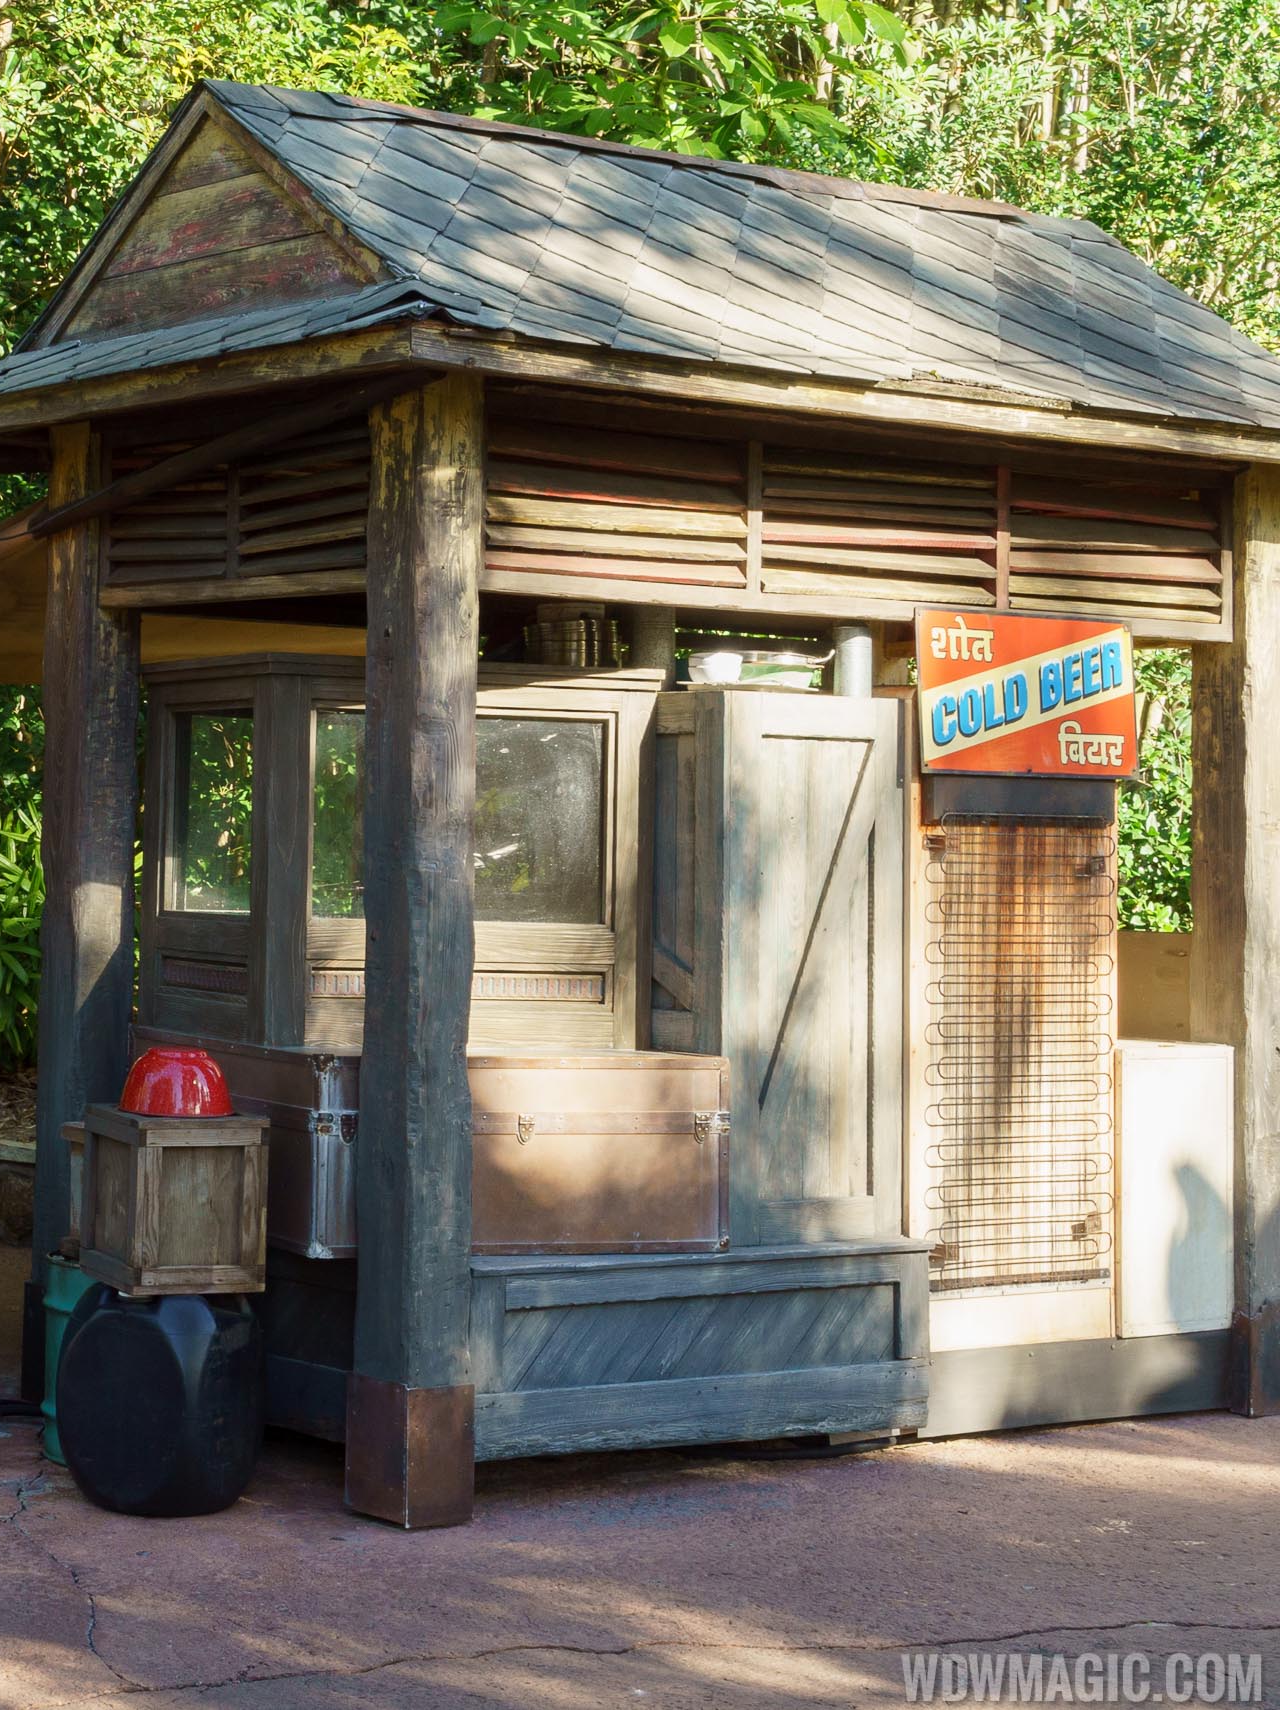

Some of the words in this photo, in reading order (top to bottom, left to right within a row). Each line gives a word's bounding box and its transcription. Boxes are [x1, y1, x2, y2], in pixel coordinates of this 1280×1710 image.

[931, 671, 1029, 746] COLD
[1039, 640, 1123, 714] BEER
[1057, 720, 1125, 767] बियर
